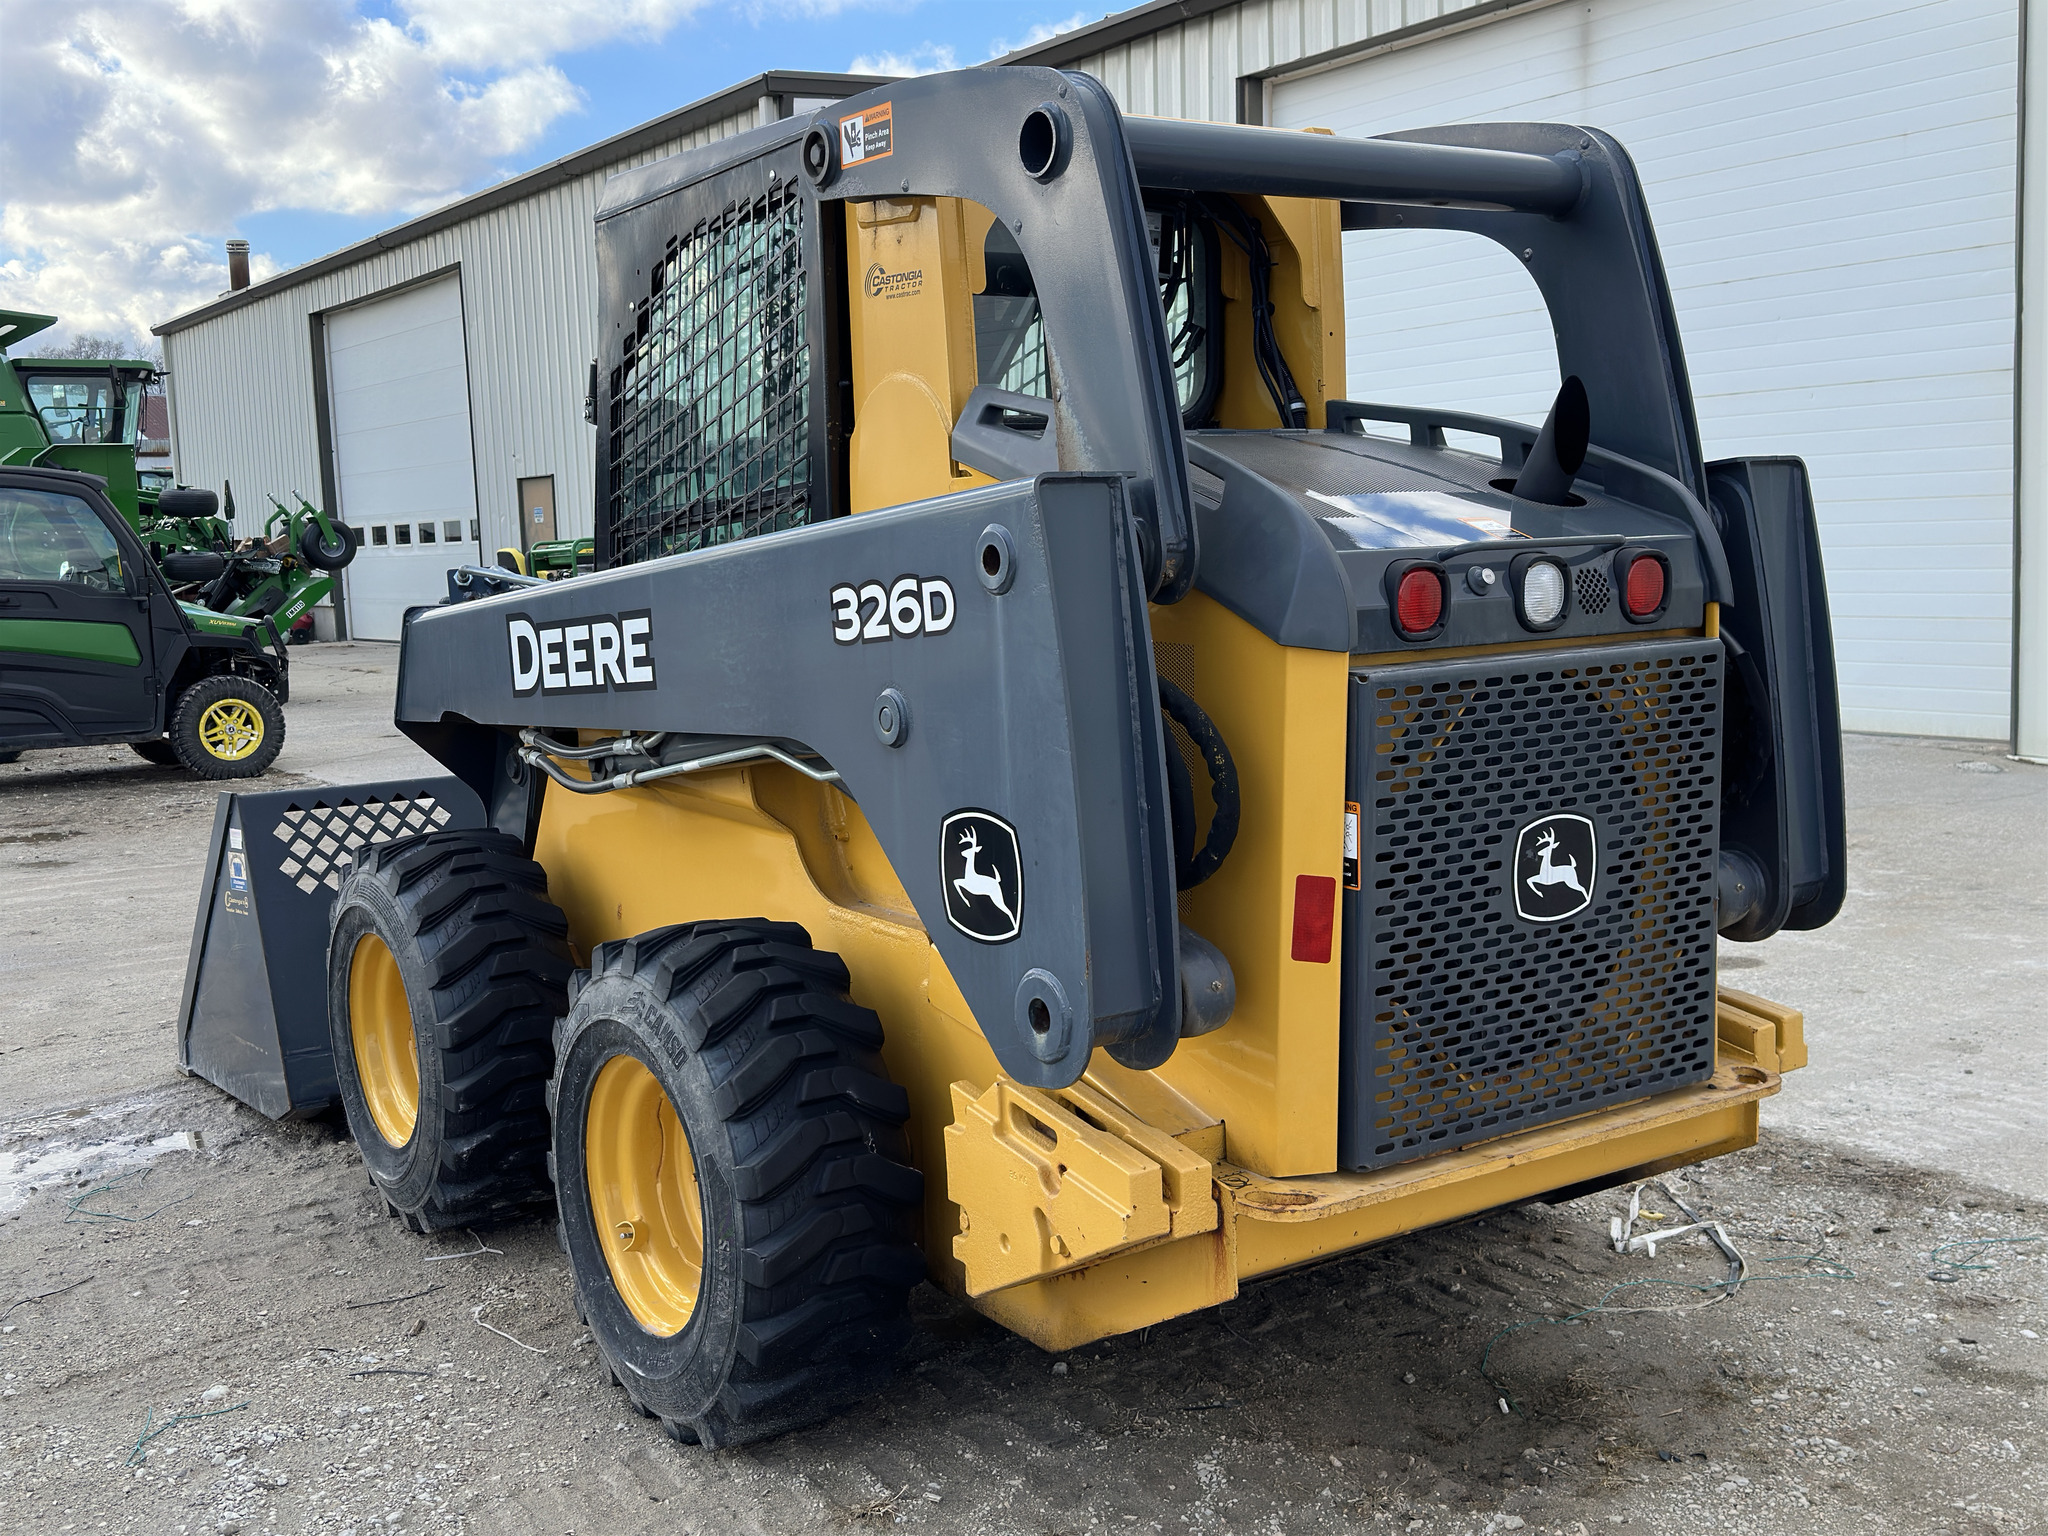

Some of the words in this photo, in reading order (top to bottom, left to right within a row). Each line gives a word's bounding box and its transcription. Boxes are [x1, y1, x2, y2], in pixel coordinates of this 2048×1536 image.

[869, 108, 890, 121] WARNING
[865, 131, 878, 141] Pinch
[879, 128, 890, 137] Area
[865, 143, 875, 151] Keep
[876, 140, 886, 148] Away
[872, 269, 922, 287] CASTONGIA
[885, 280, 923, 292] TRACTOR
[831, 578, 956, 642] 326D
[508, 616, 655, 692] DEERE
[643, 1004, 689, 1072] CAMSO
